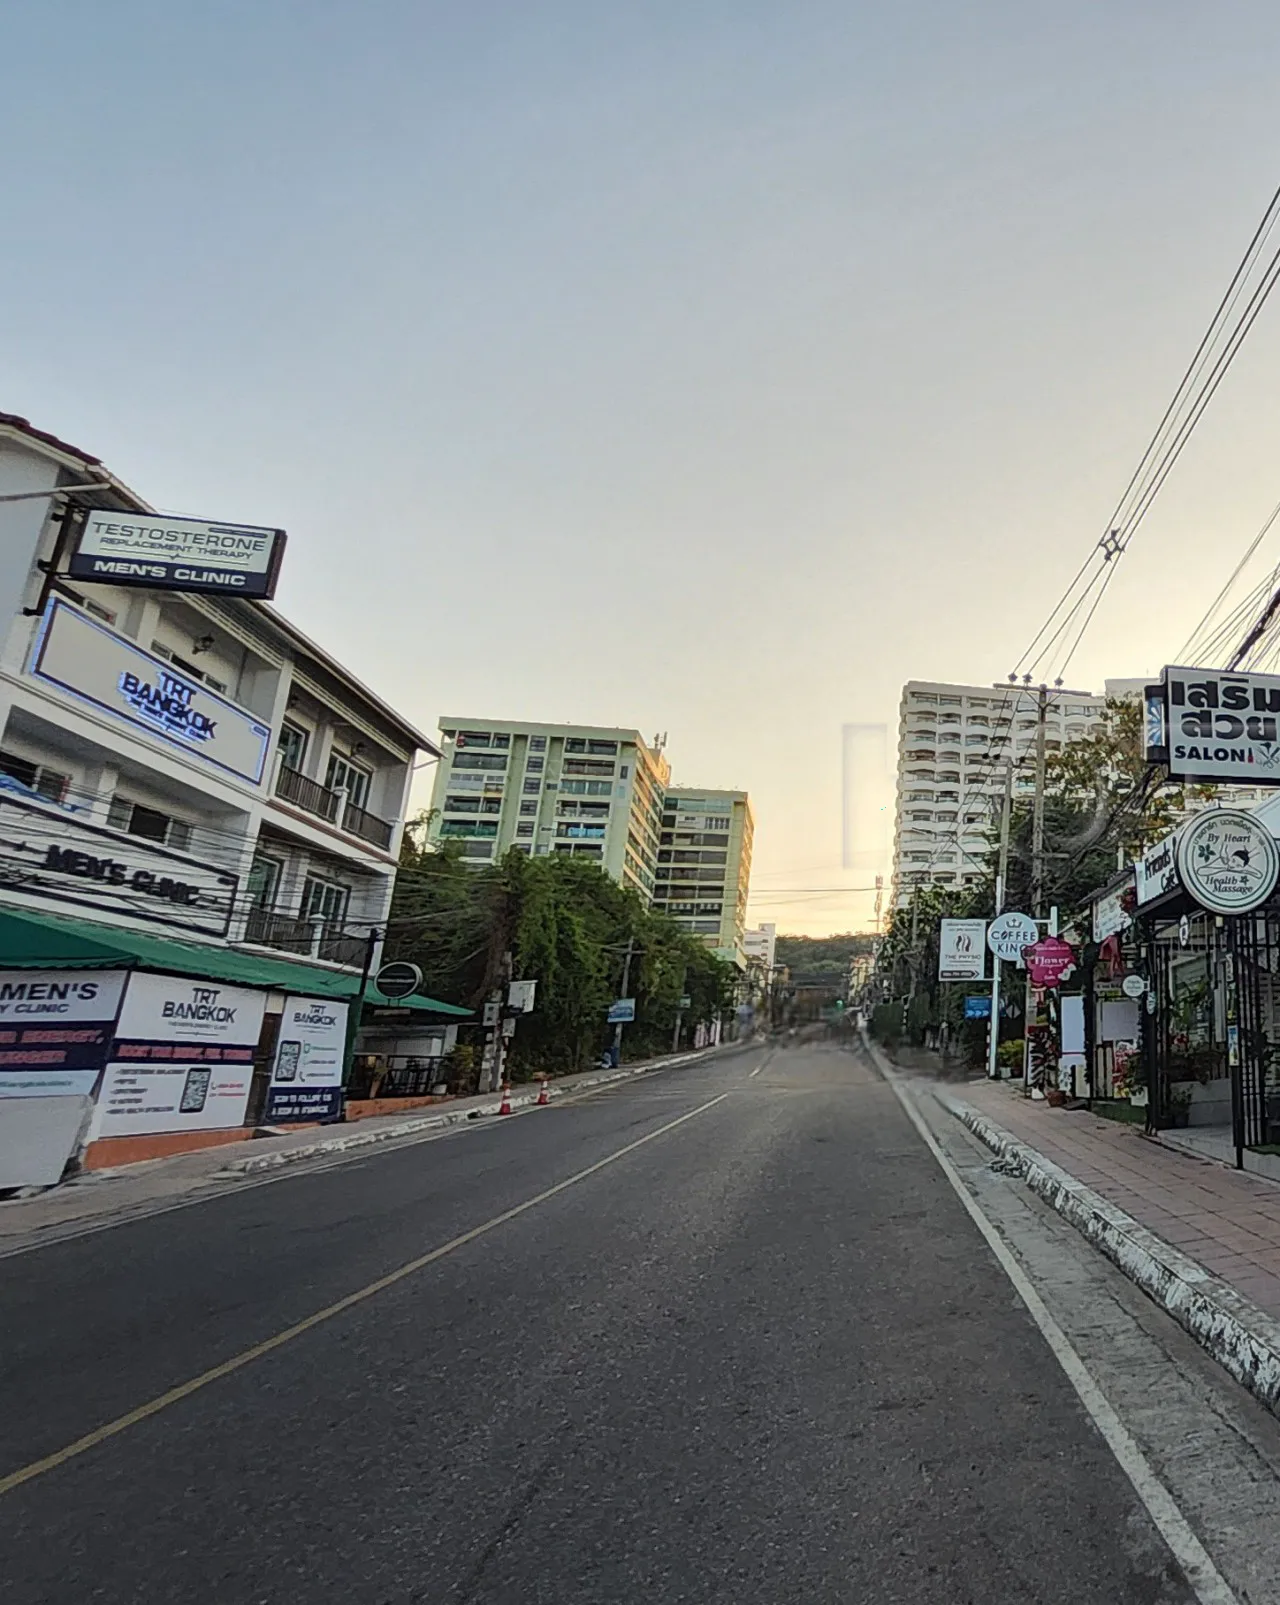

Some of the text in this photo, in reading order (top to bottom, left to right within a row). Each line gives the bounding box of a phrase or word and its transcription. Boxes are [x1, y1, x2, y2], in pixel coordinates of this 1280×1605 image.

[92, 521, 266, 552] TESTOSTERONE
[100, 536, 253, 560] REPLACEMENT THERAPY
[93, 560, 247, 586] MEN'S CLINIC
[160, 671, 197, 705] TRT
[120, 672, 218, 739] BANGKOK
[1180, 710, 1278, 742] สวย
[1174, 745, 1246, 763] SALON
[1207, 833, 1252, 845] By Heart
[1205, 875, 1238, 885] Health
[1212, 882, 1254, 895] Massage
[990, 931, 1037, 940] COFFEE
[0, 983, 99, 1001] MEN'S
[192, 987, 221, 1005] TRT
[14, 1003, 70, 1014] CLINIC
[161, 1001, 238, 1024] BANGKOK
[293, 1012, 338, 1026] BANGKOK
